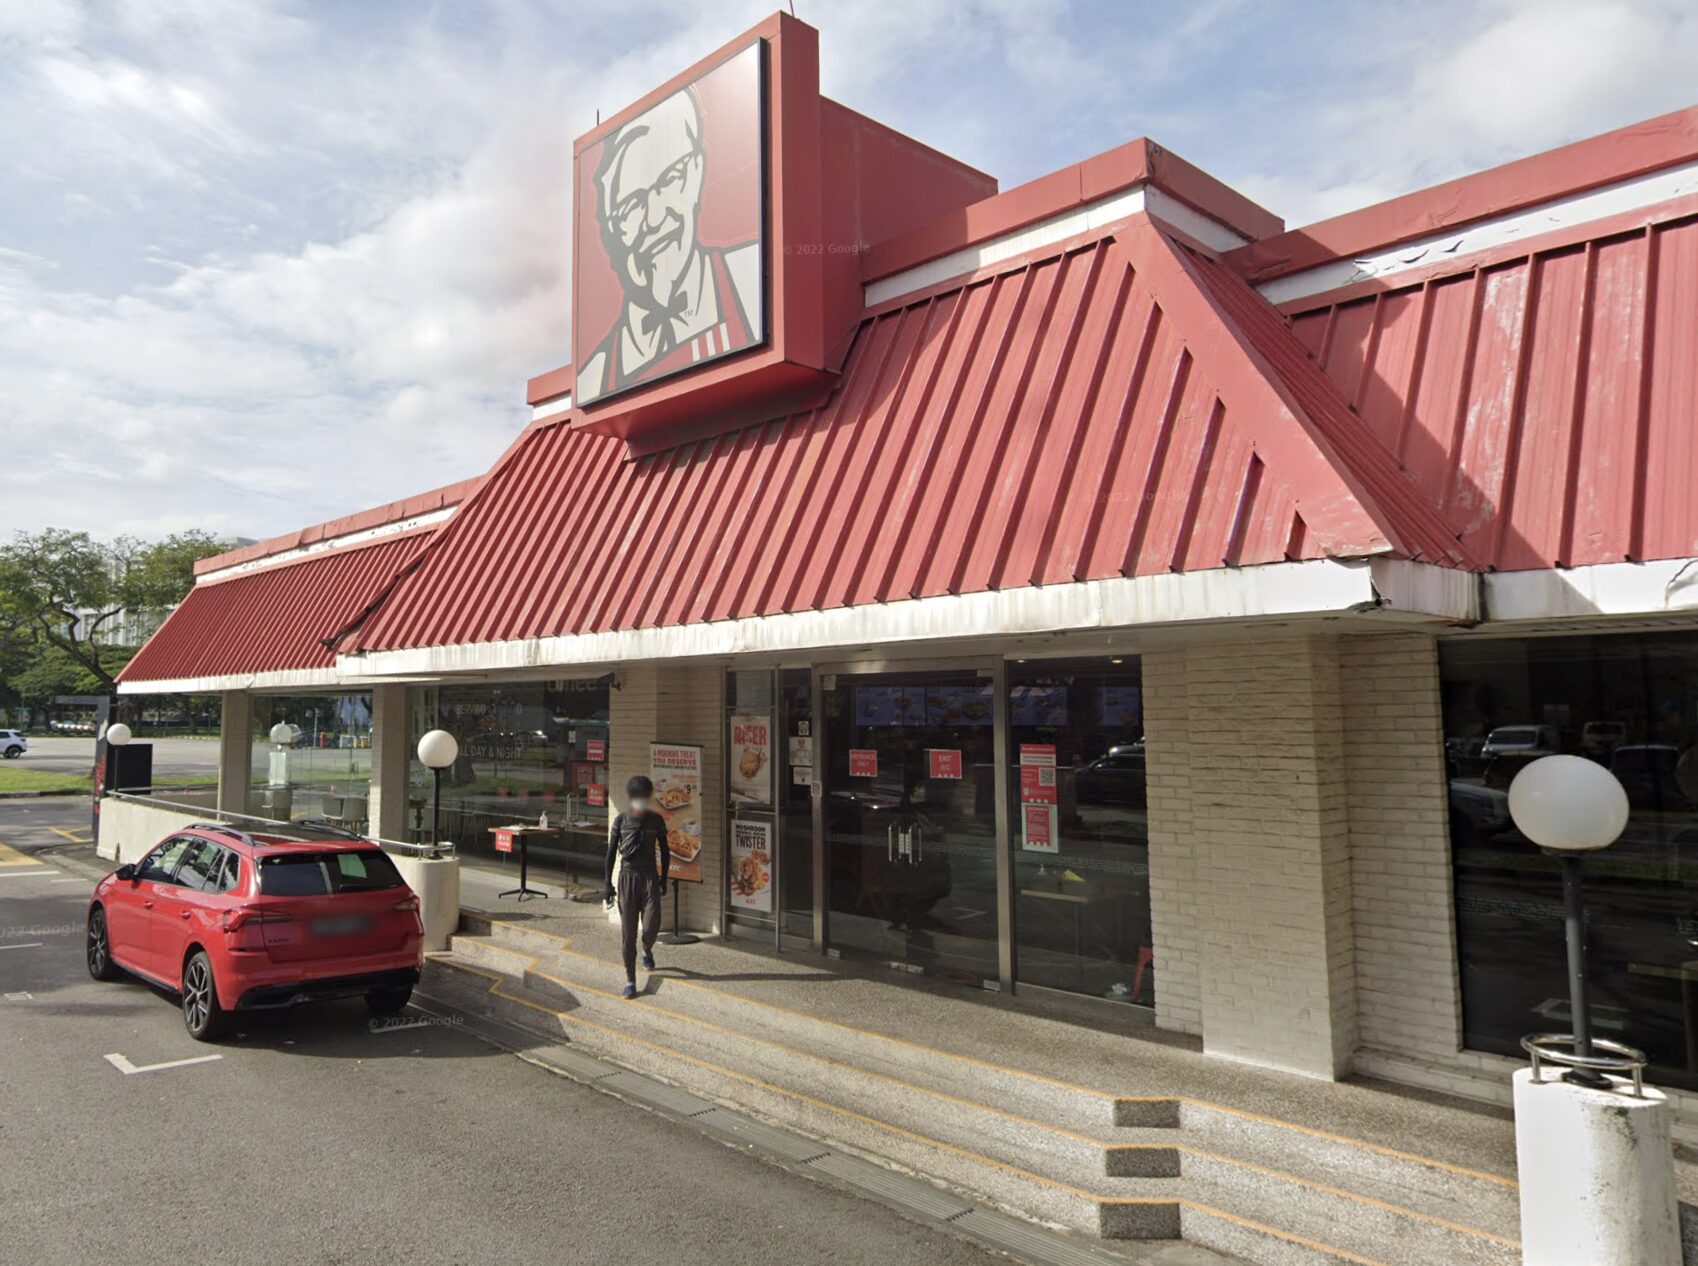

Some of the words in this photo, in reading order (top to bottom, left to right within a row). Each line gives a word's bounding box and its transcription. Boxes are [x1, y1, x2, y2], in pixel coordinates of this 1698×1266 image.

[470, 746, 486, 757] DAY
[488, 747, 494, 757] &
[497, 746, 522, 759] NIGHT
[736, 824, 766, 832] MUSHROOM
[736, 834, 766, 850] TWISTER
